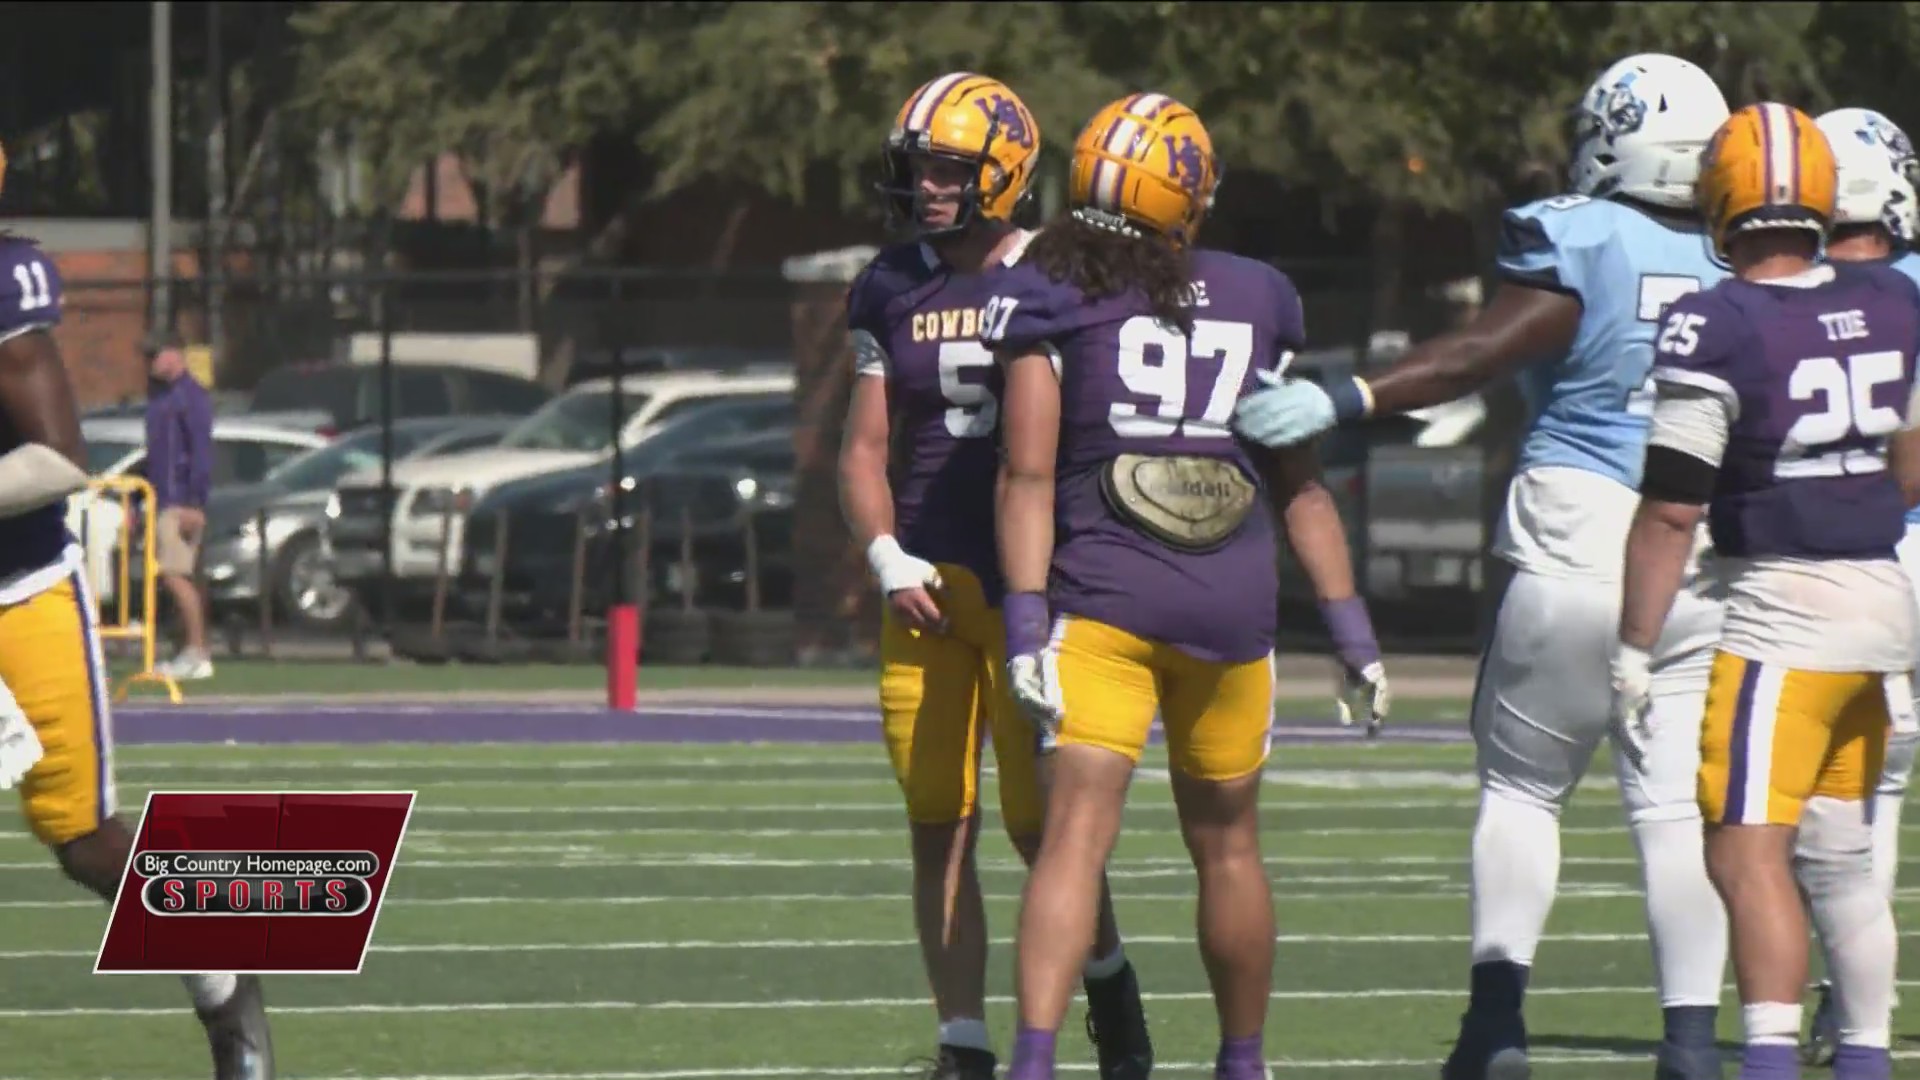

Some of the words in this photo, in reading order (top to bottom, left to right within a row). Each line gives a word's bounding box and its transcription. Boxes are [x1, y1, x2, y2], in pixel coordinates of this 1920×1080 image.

[13, 261, 51, 311] 11
[981, 295, 1019, 340] 97
[1660, 312, 1707, 357] 25
[938, 341, 998, 438] 5
[1108, 315, 1253, 437] 97
[1774, 351, 1904, 477] 25
